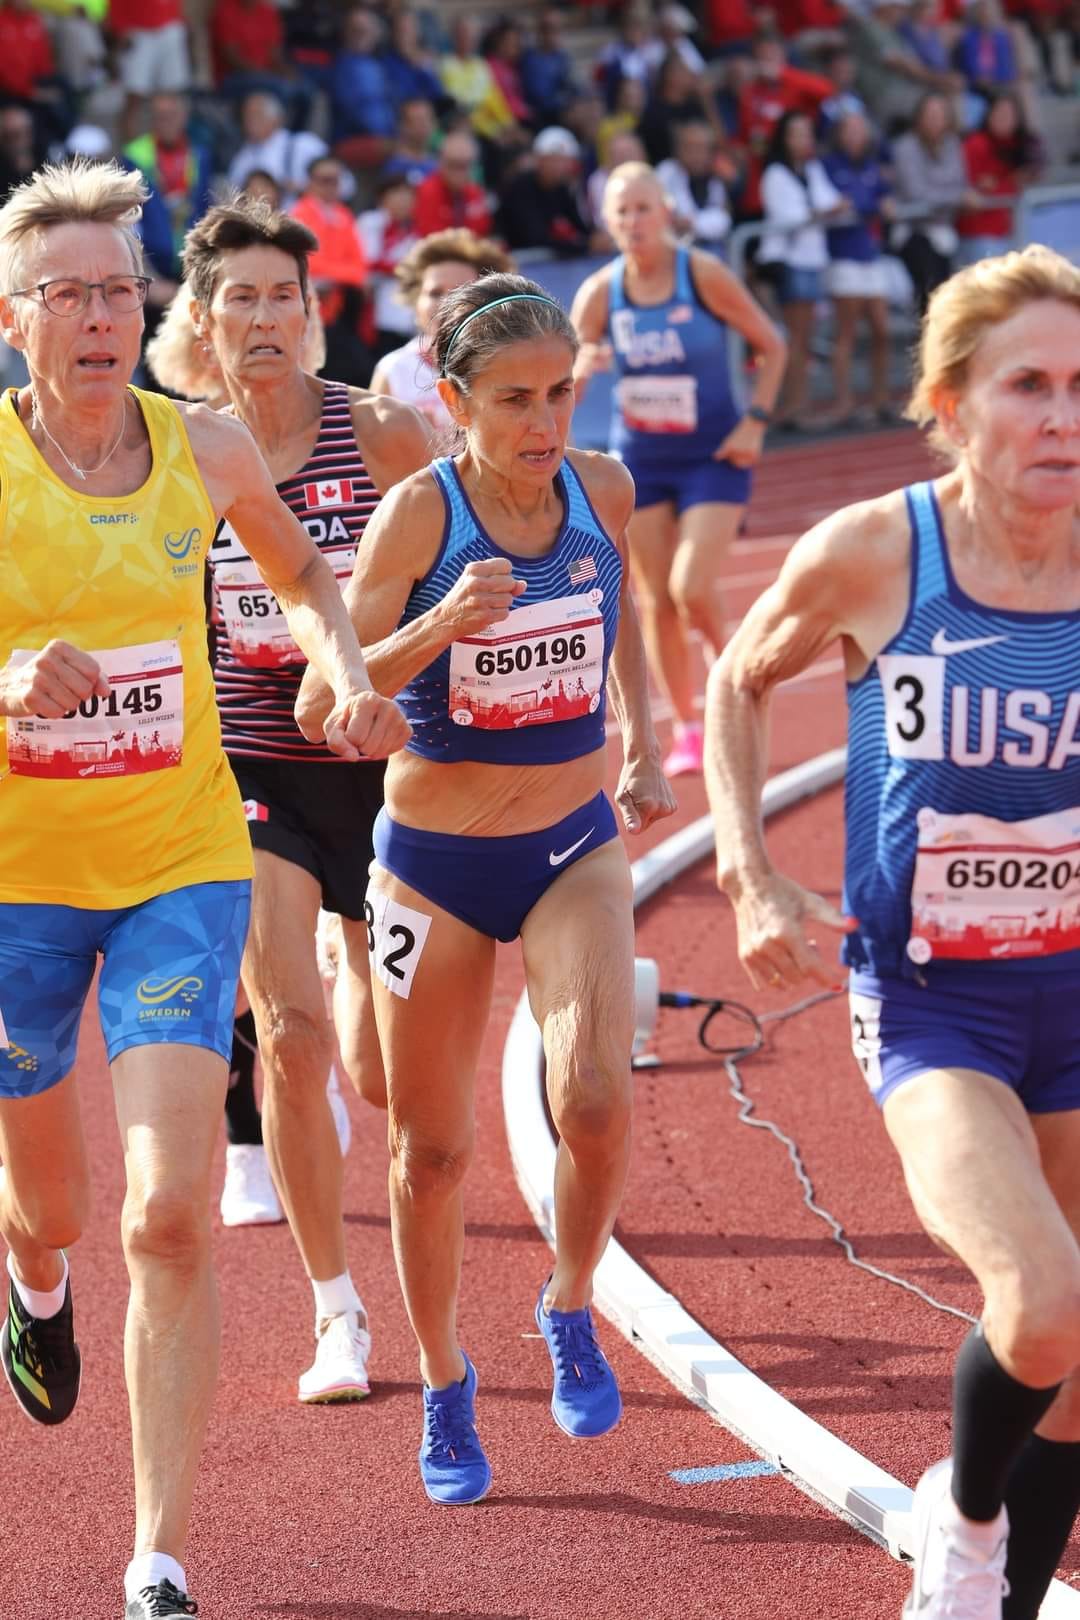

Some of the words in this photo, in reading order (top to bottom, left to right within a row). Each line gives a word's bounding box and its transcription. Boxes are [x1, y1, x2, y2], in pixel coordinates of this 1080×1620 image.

[90, 513, 129, 525] CRAFT
[302, 515, 351, 543] DA
[238, 594, 284, 618] 651
[475, 633, 587, 677] 650196
[477, 679, 491, 687] USA
[36, 684, 163, 720] 0145
[894, 674, 925, 742] 3
[951, 685, 1080, 770] USA
[138, 1007, 191, 1019] SWEDEN
